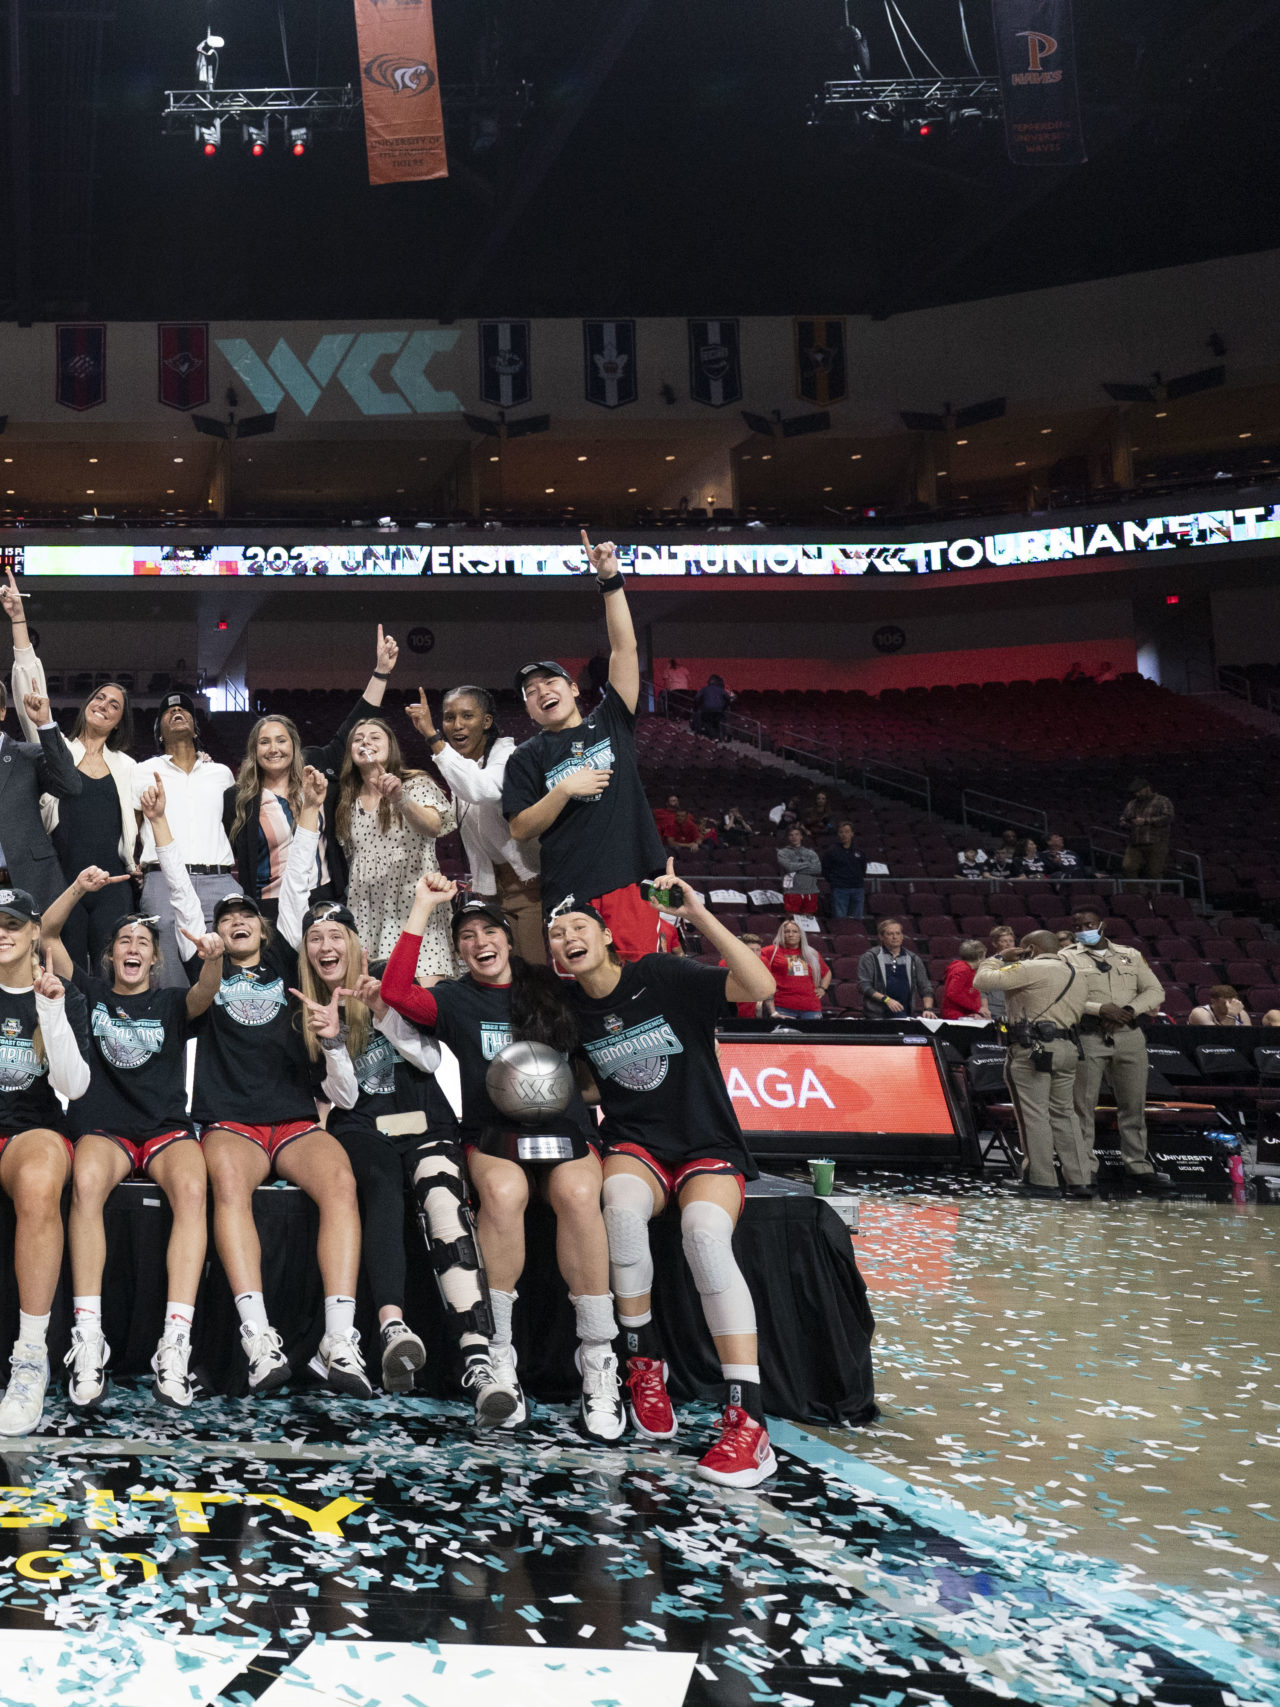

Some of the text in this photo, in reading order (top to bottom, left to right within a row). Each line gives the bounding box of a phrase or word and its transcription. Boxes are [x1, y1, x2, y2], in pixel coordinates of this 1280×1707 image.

[371, 136, 426, 149] UNIVERSITY
[214, 329, 466, 417] WCC
[5, 547, 14, 556] 15
[1156, 1152, 1214, 1162] UNIVERSITY
